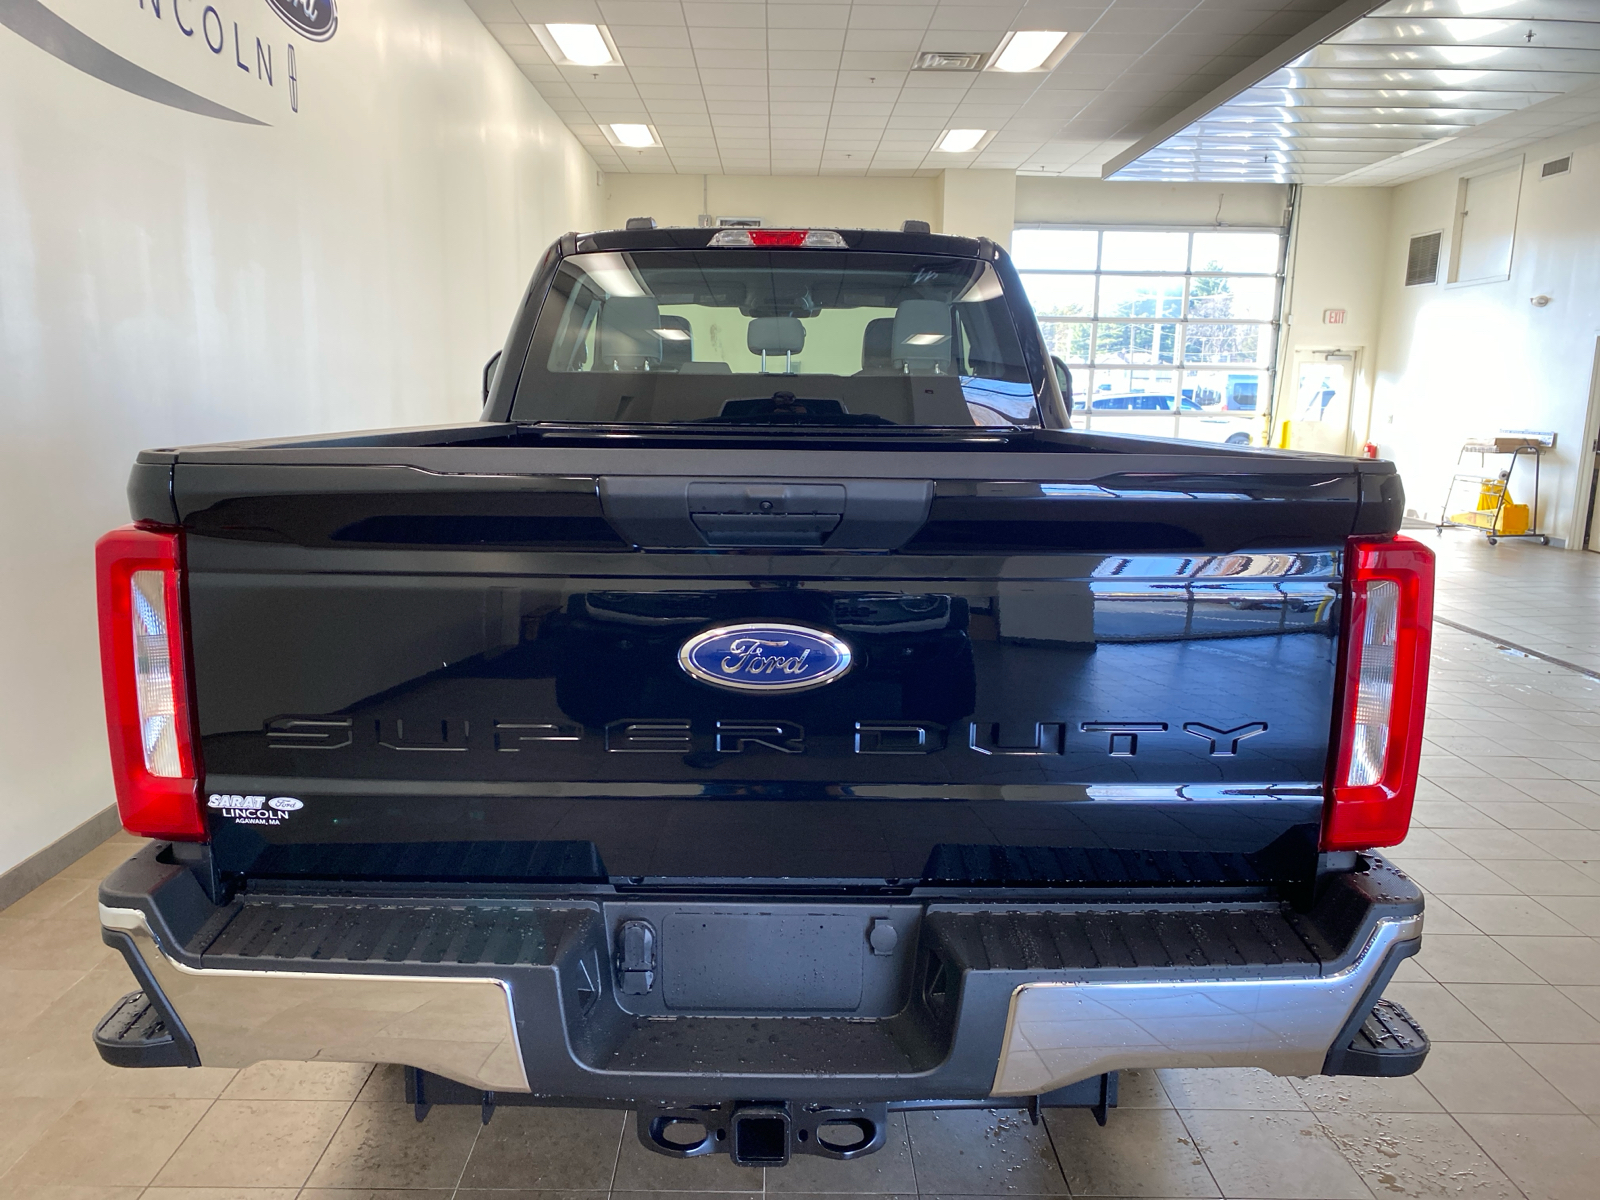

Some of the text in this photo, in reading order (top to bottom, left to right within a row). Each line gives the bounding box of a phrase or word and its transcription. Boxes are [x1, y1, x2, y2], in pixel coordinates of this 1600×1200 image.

[1329, 310, 1345, 324] EXIT
[721, 637, 811, 674] Ford
[262, 713, 1269, 756] SUPER DUTY
[208, 794, 266, 809] SARAT
[222, 809, 289, 819] LINCOLN
